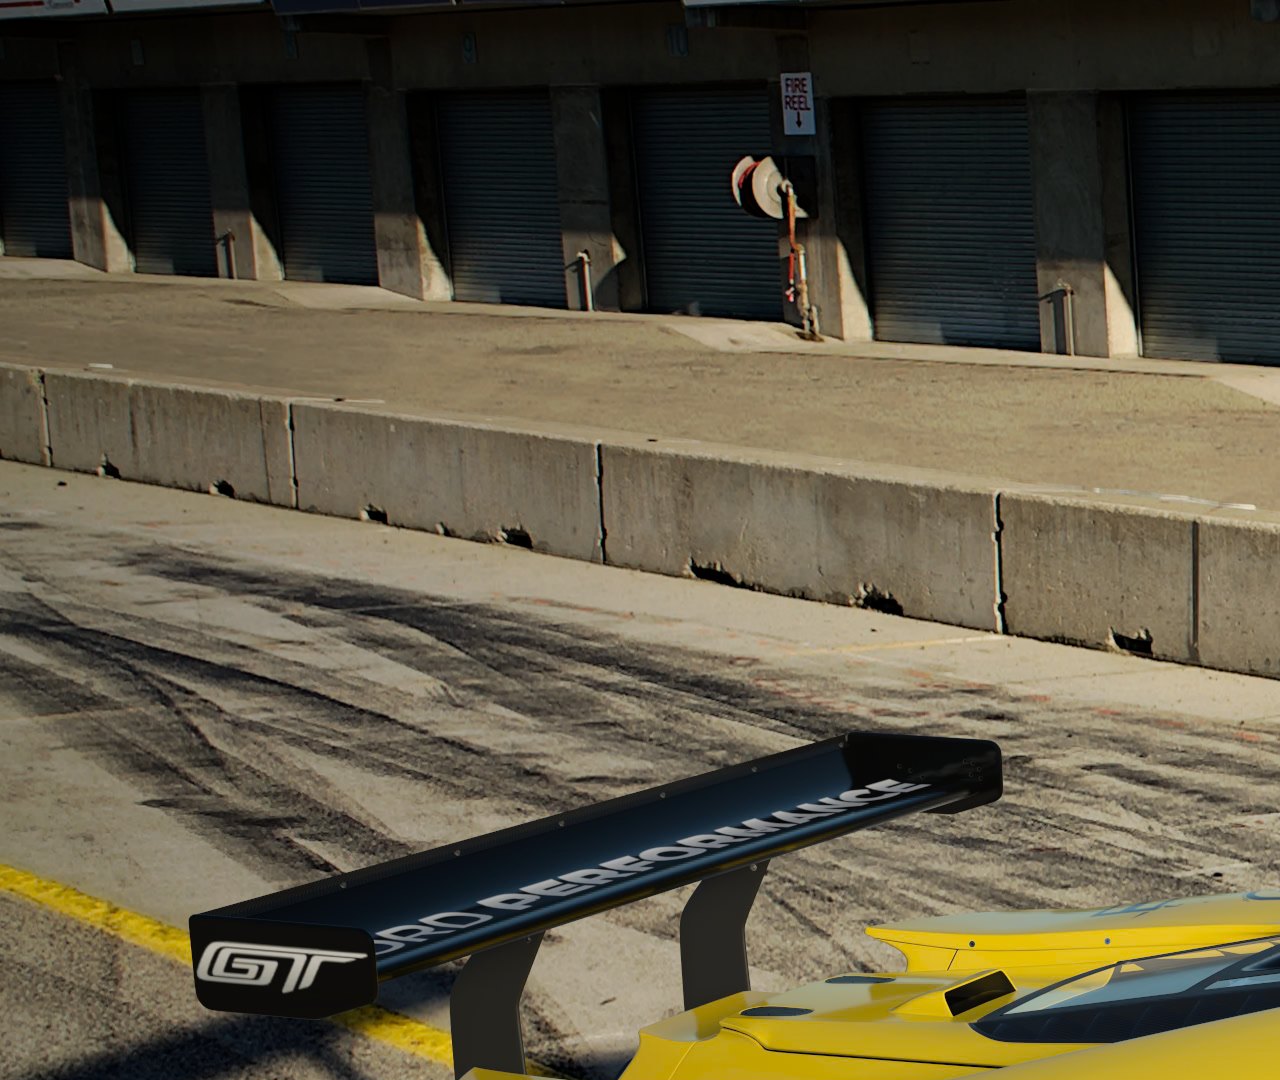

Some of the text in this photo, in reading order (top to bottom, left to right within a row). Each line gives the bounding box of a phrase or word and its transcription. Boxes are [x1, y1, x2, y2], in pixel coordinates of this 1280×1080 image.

[785, 78, 807, 93] FIRE
[785, 95, 810, 110] REEL
[477, 778, 932, 911] PERFORMANCE
[196, 940, 368, 995] GT
